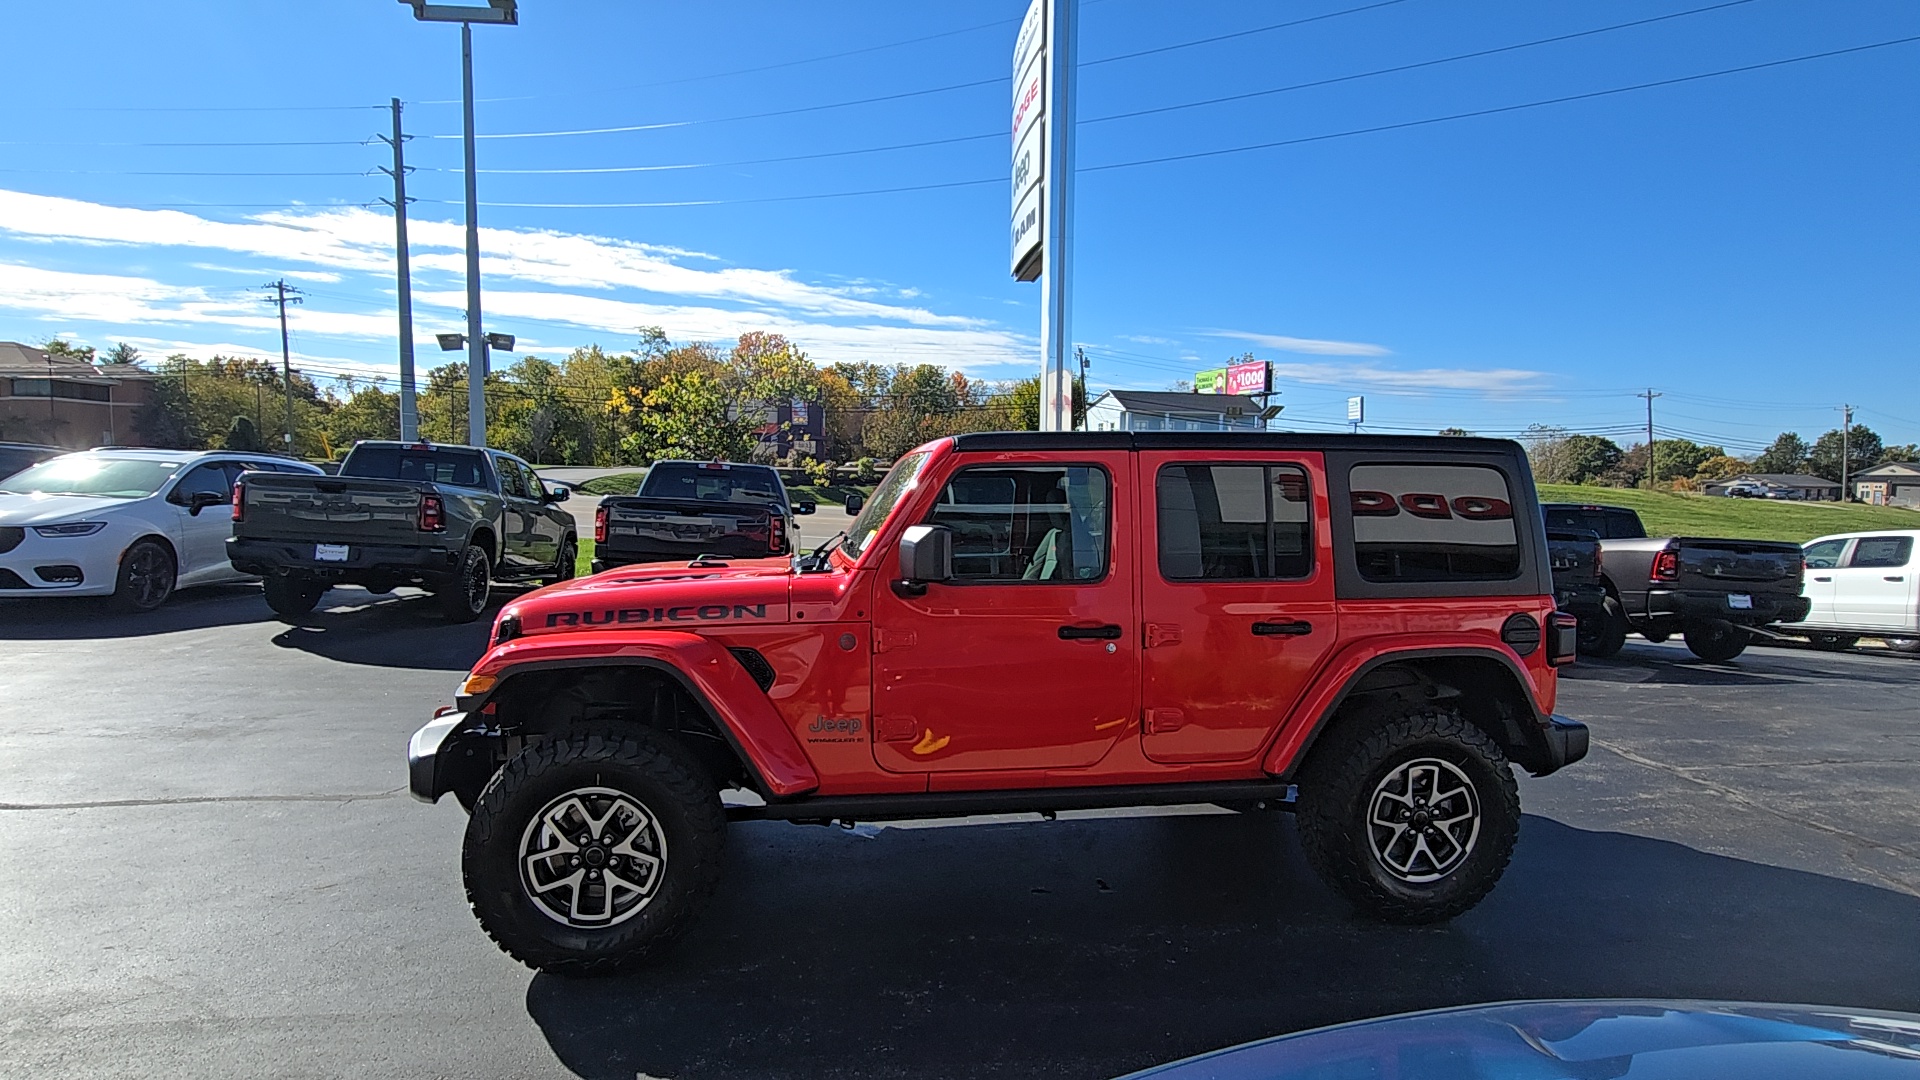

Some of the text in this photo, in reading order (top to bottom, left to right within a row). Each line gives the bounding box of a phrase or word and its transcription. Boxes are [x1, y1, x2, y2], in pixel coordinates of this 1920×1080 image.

[1014, 206, 1036, 247] RAM
[546, 604, 766, 628] RUBICON
[808, 714, 862, 735] Jeep
